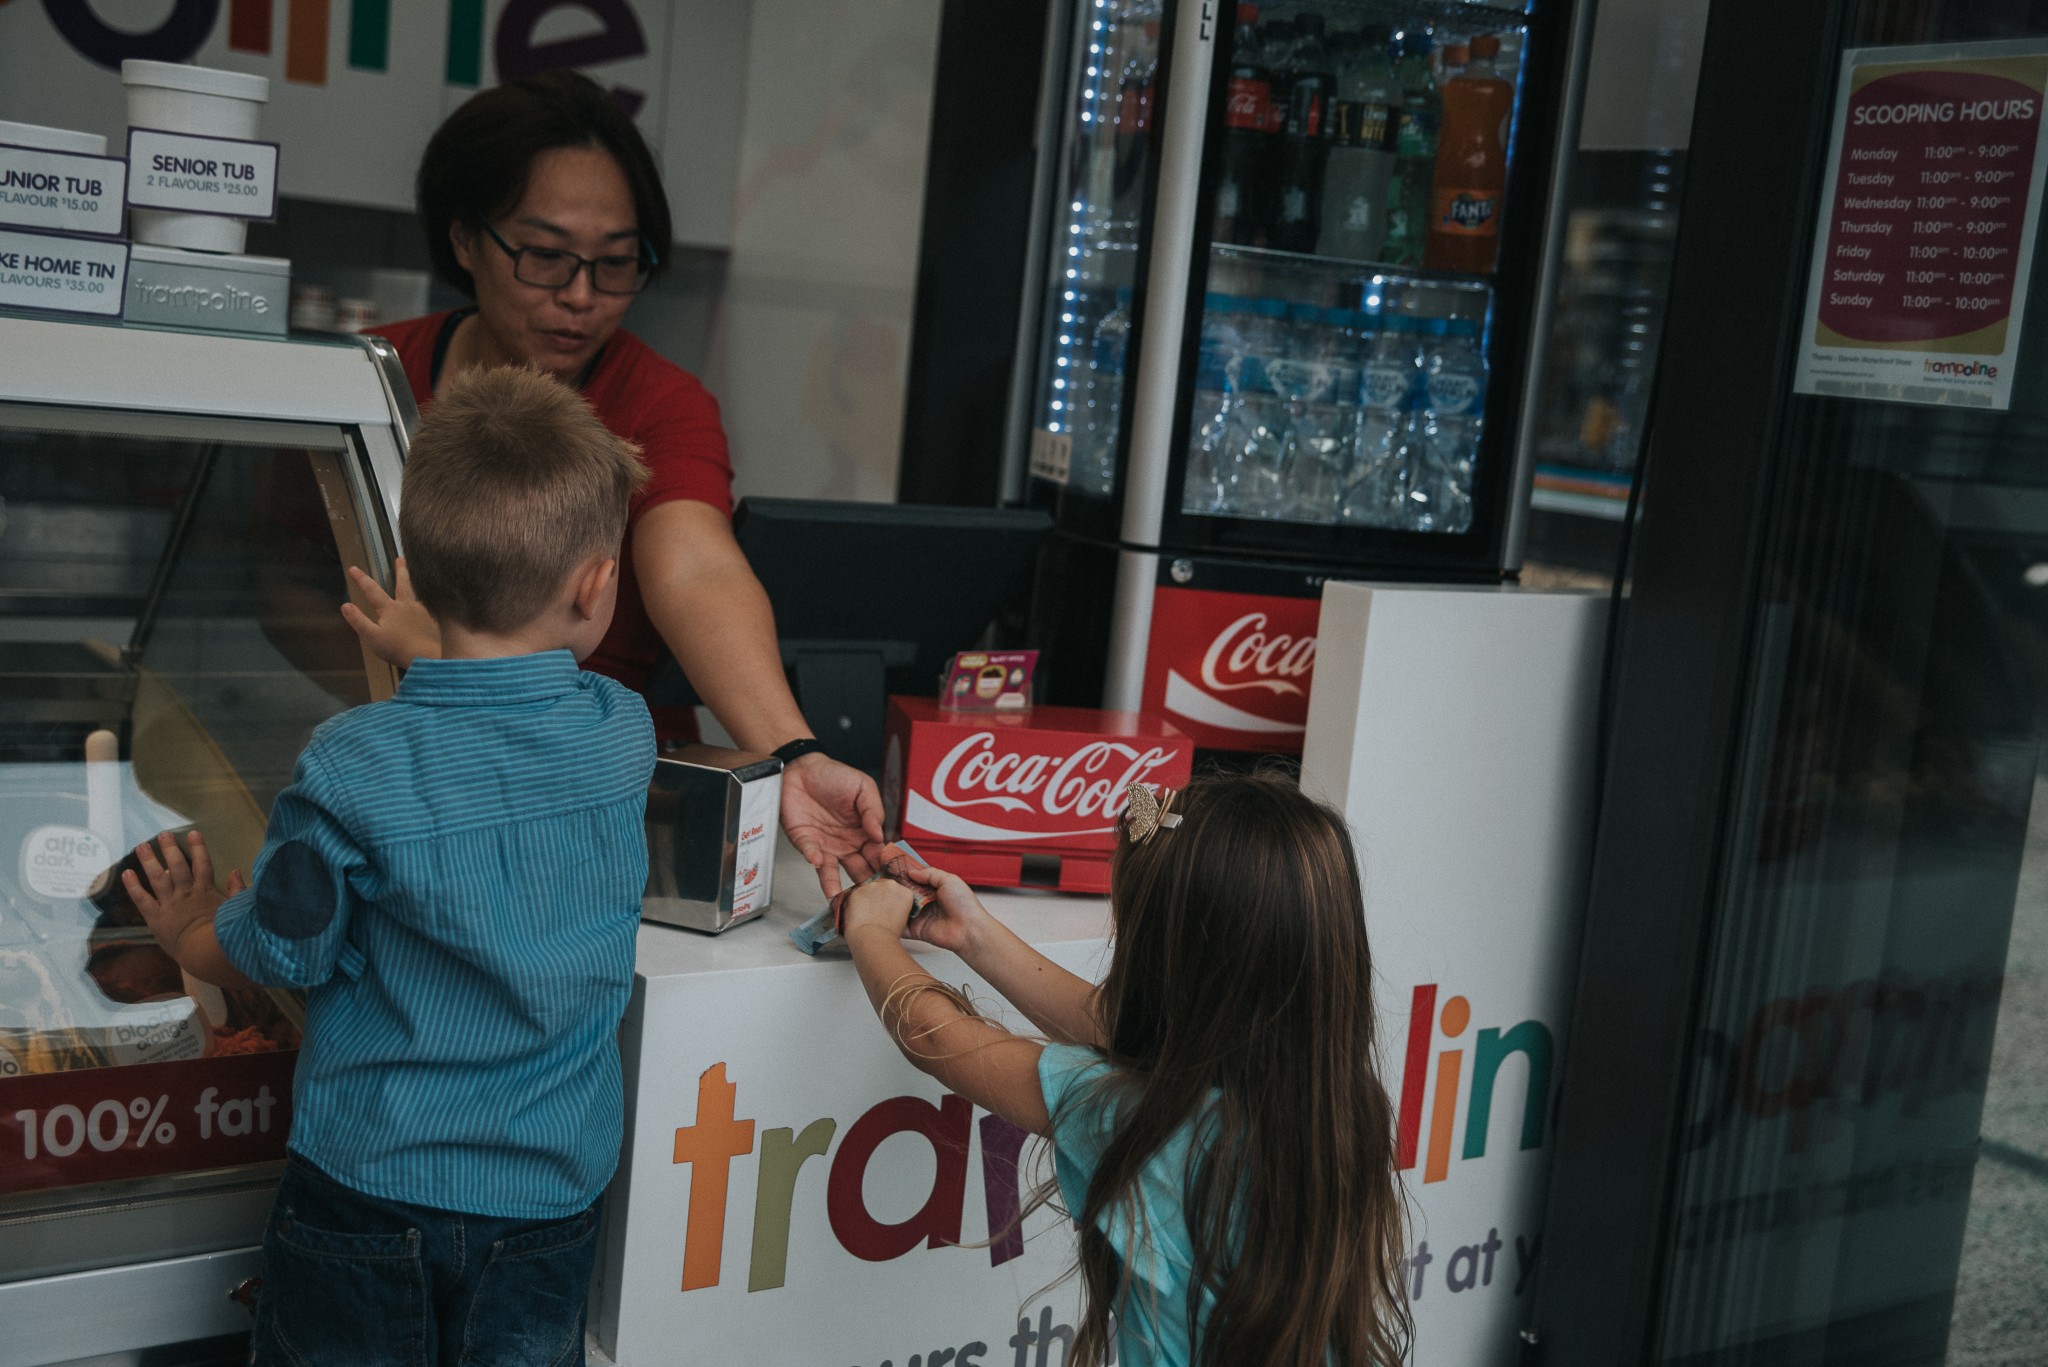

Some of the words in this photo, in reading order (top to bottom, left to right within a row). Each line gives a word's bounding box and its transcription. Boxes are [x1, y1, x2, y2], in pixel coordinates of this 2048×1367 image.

[1854, 102, 1954, 126] SCOOPING
[1960, 99, 2034, 122] HOURS
[1851, 148, 1899, 162] Monday
[152, 155, 217, 177] SENIOR
[222, 162, 255, 181] TUB
[65, 177, 103, 197] TUB
[147, 175, 154, 186] 2
[159, 176, 220, 193] FLAVOURS
[224, 183, 258, 197] $25.00
[1848, 172, 1894, 187] Tuesday
[62, 196, 98, 212] $15.00
[1844, 196, 1911, 211] Wednesday
[1840, 221, 1892, 236] Thursday
[1836, 245, 1871, 260] Friday
[24, 255, 81, 276] HOME
[87, 261, 116, 280] TIN
[1834, 269, 1884, 285] Saturday
[0, 272, 62, 289] LAVOURS
[65, 278, 104, 294] $35.00
[135, 278, 269, 314] trampoline
[1830, 293, 1872, 309] Sunday
[1924, 358, 1998, 378] trampoline
[931, 732, 1178, 819] Coca-Col
[45, 836, 100, 857] after
[34, 850, 74, 868] dark
[137, 1020, 189, 1051] orange
[15, 1094, 176, 1160] 100%
[194, 1085, 277, 1139] fat
[1446, 1228, 1502, 1293] at
